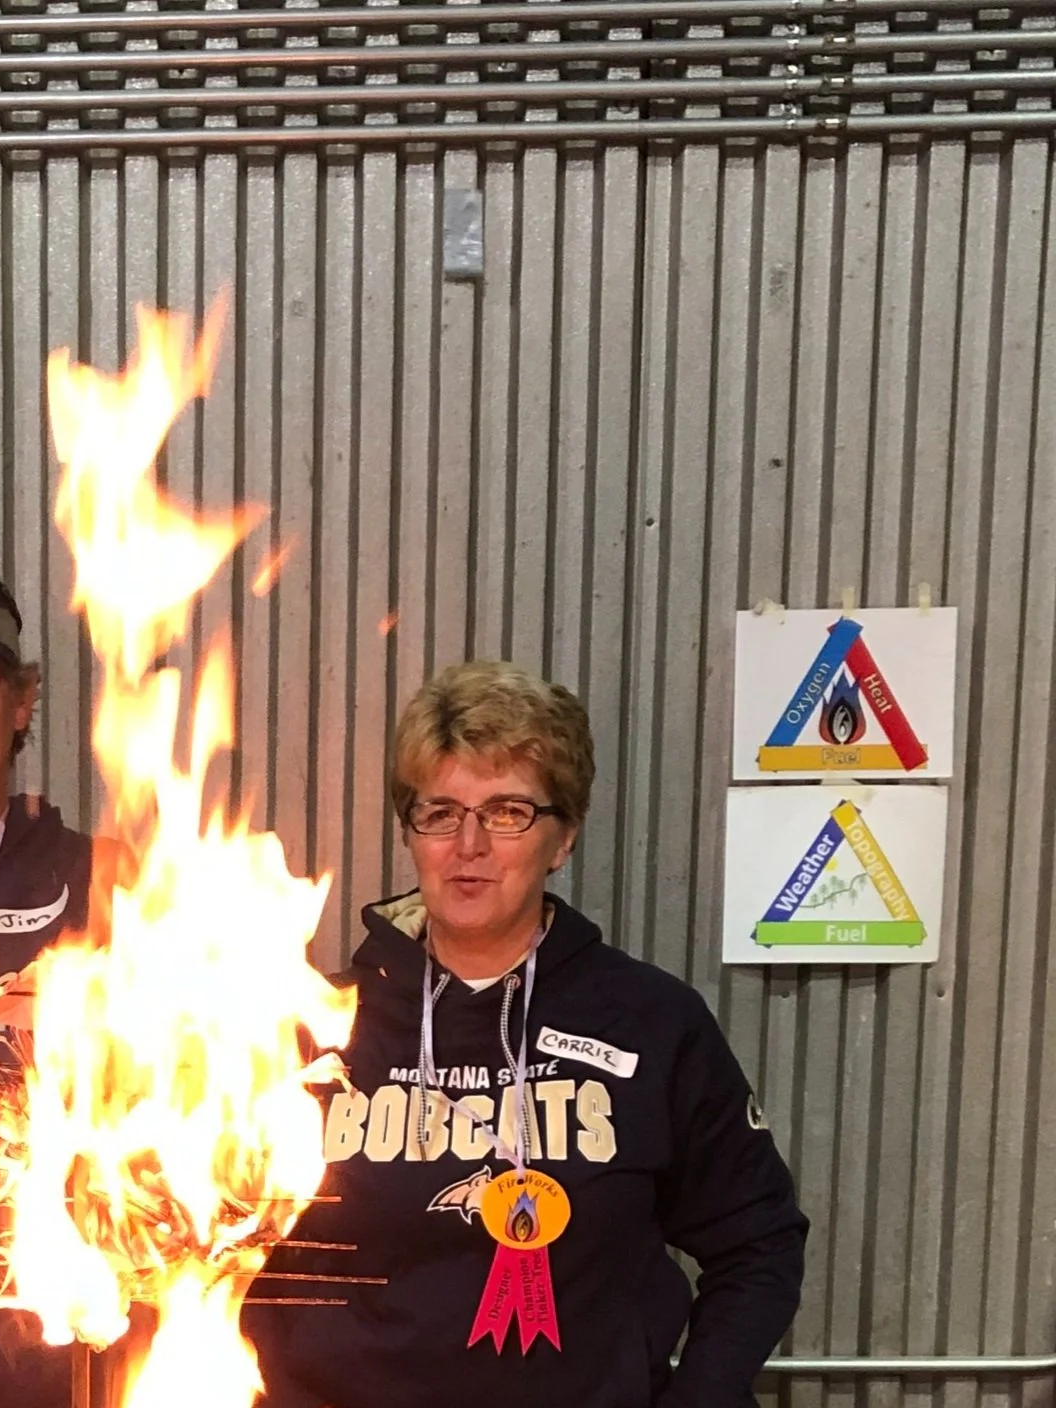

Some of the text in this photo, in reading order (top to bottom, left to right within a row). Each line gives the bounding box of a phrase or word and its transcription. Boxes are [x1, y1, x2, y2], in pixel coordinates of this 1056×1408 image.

[786, 662, 831, 724] Oxygen
[863, 673, 893, 714] Heat
[821, 747, 862, 765] Fuel
[774, 833, 836, 913] Weather
[846, 818, 912, 922] Topography
[824, 924, 867, 943] Fuel
[542, 1033, 617, 1068] CARRIE
[497, 1058, 560, 1086] SATE
[323, 1079, 618, 1163] BOBCATS
